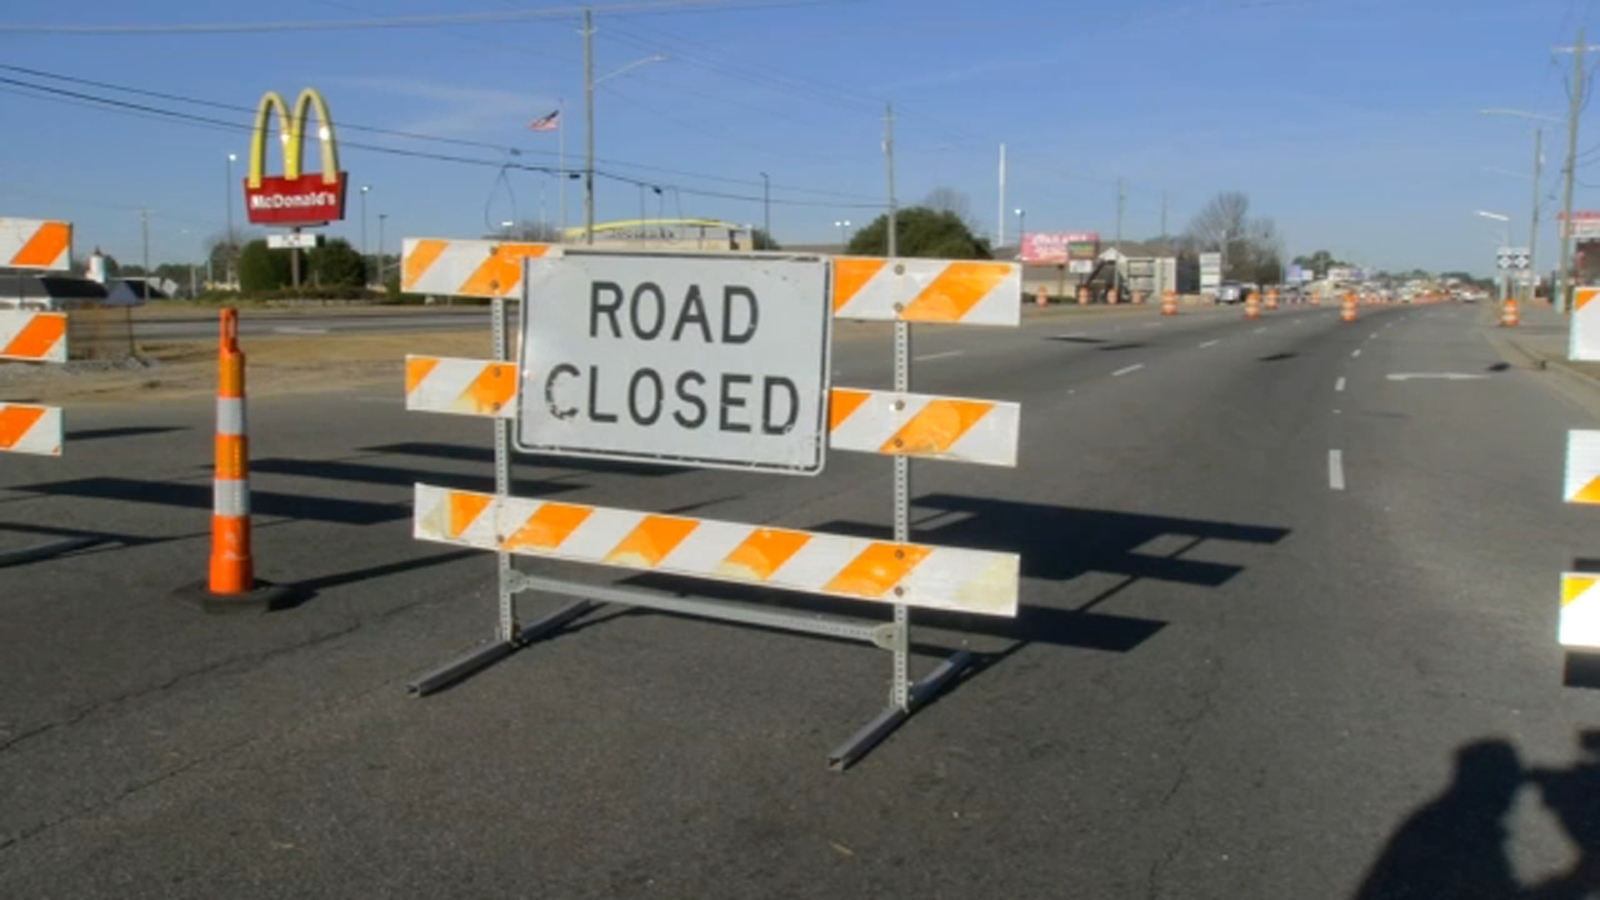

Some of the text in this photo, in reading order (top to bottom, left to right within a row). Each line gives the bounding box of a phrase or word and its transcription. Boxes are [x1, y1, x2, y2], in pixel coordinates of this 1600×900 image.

[250, 192, 336, 210] McDonald's
[589, 280, 759, 345] ROAD
[545, 362, 799, 435] CLOSED
